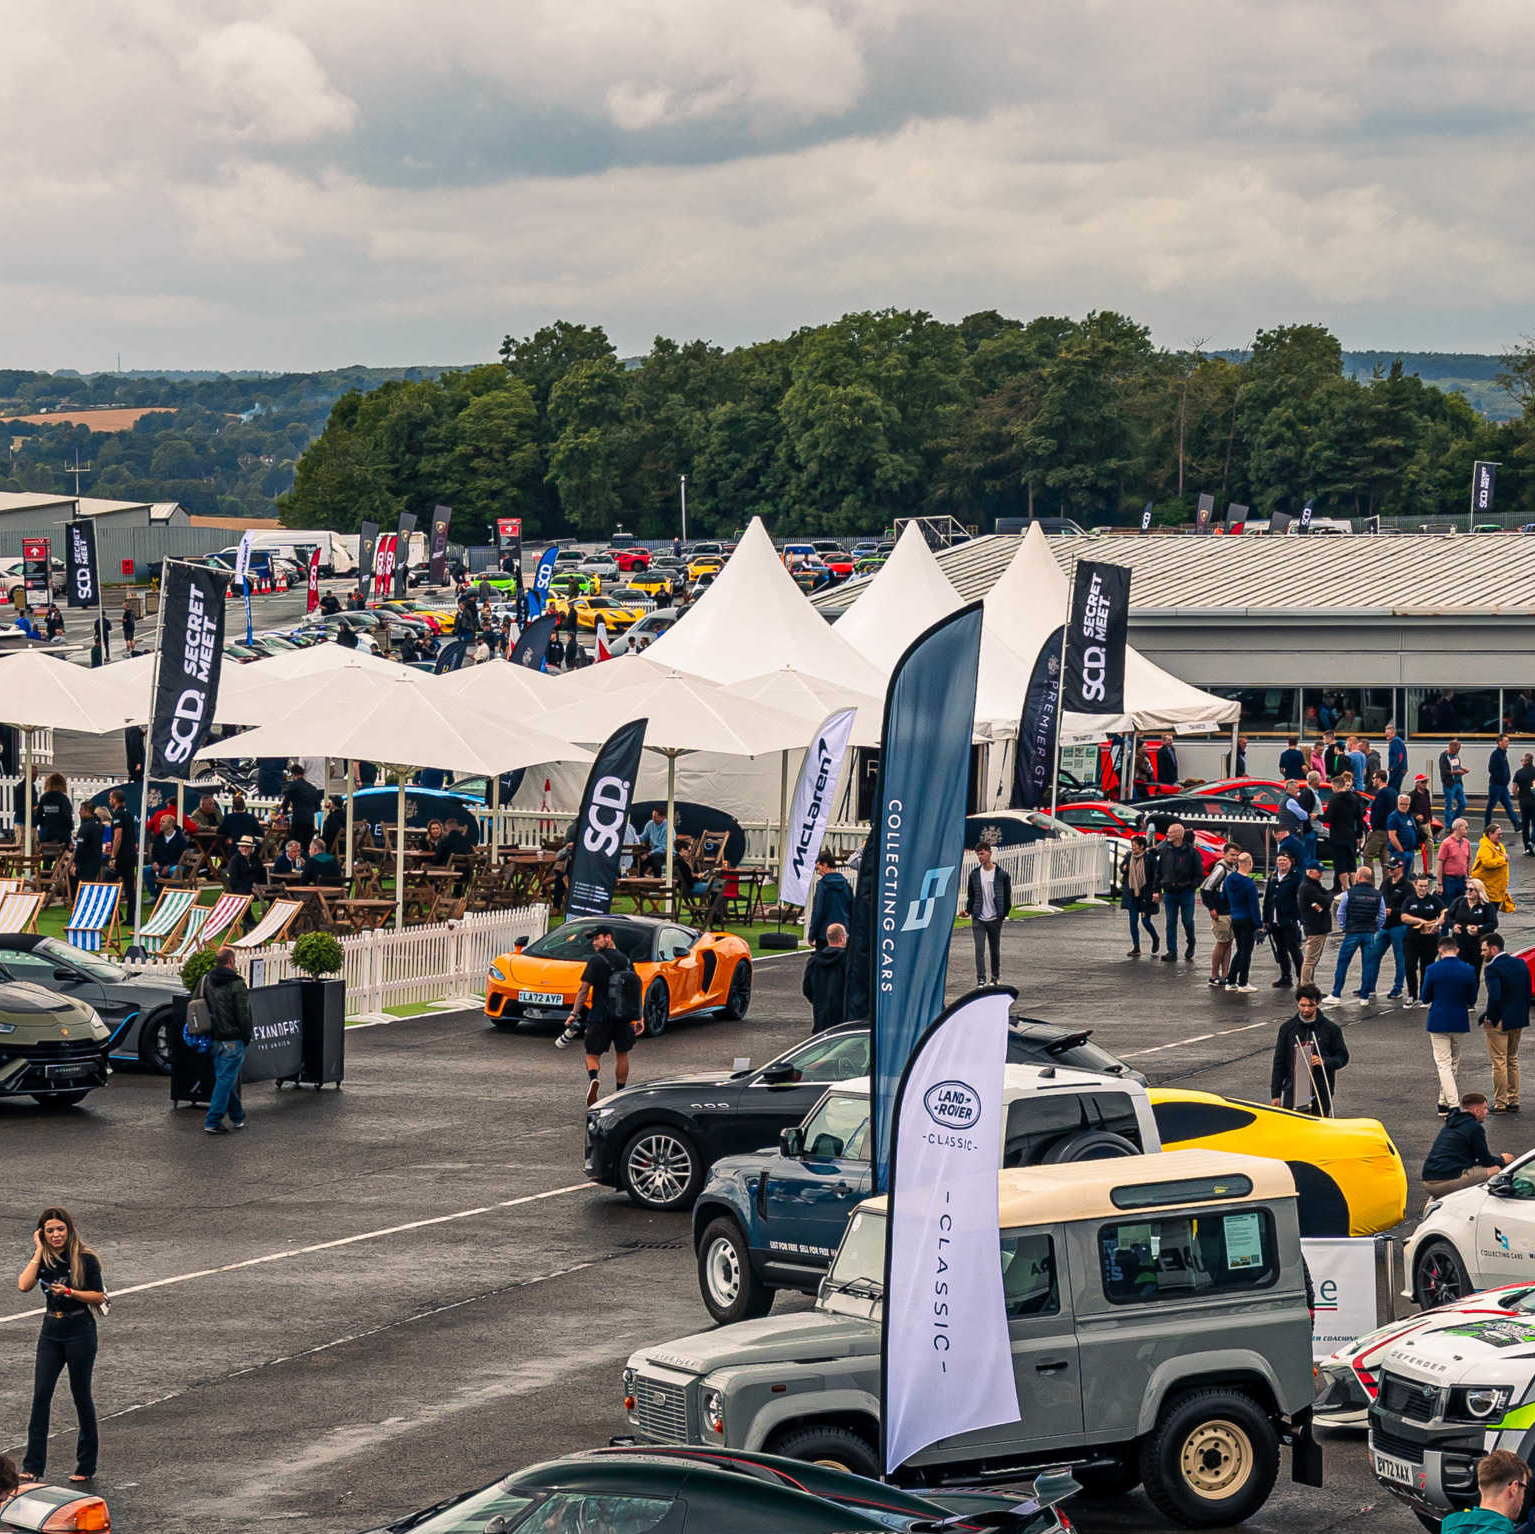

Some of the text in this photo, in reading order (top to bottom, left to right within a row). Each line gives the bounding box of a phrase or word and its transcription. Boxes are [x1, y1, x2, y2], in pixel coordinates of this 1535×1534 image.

[537, 563, 553, 589] SCD
[1083, 573, 1103, 638] SECRET
[184, 583, 204, 676] SECRET
[1033, 680, 1060, 788] PREMIER GT
[792, 756, 833, 881] McLaren
[879, 798, 904, 993] COLLECTING CARS
[548, 994, 564, 1005] AYP
[937, 1104, 973, 1121] ROVER
[938, 1087, 965, 1106] LAND
[934, 1214, 953, 1353] CLASSIC
